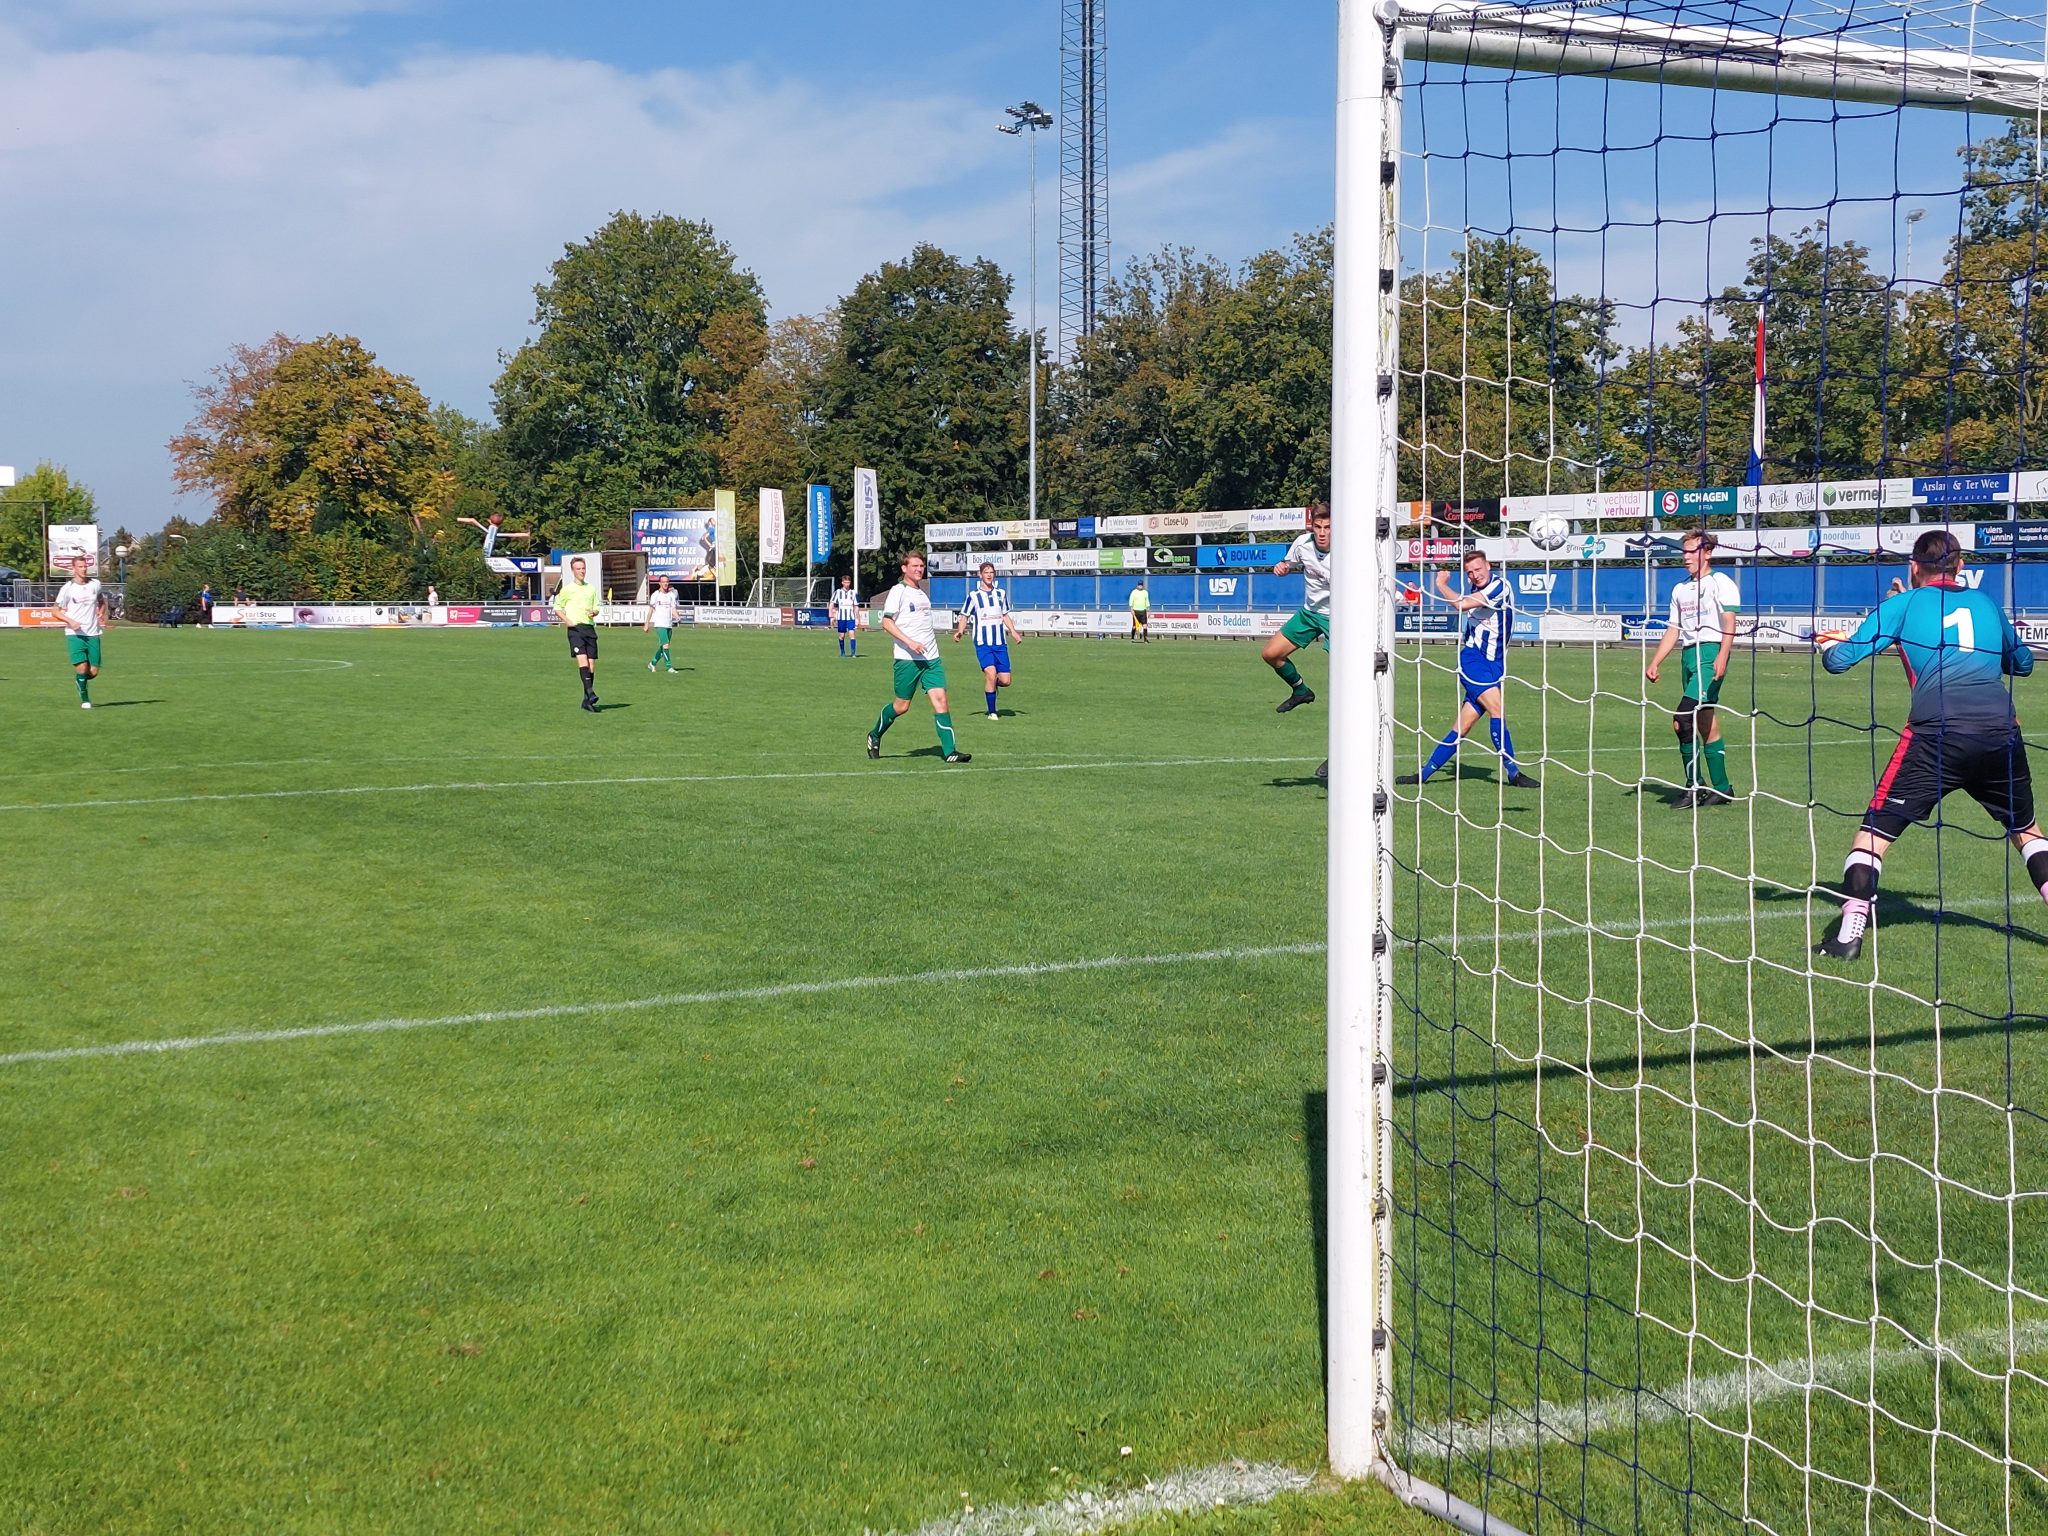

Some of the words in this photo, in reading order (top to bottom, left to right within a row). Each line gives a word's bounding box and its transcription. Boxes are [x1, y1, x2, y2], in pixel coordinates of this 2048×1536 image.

[1953, 481, 1962, 490] &
[1966, 480, 1979, 489] Ter
[1981, 479, 2000, 489] Wee
[863, 474, 874, 509] USV
[1683, 491, 1729, 503] SCHAGEN
[1839, 485, 1887, 503] vermeij
[1604, 493, 1640, 505] vechtdal
[1665, 494, 1676, 512] S
[1448, 513, 1486, 521] Comagner
[1605, 506, 1641, 516] verhuur
[638, 519, 650, 530] FF
[652, 518, 706, 530] BIJTANKEN
[1163, 516, 1189, 527] Close-Up
[983, 525, 1000, 536] USV
[1823, 530, 1861, 540] noordhuis
[641, 537, 656, 545] AAN
[657, 537, 667, 545] DE
[668, 537, 688, 545] POMP
[817, 526, 826, 555] JANSEN
[520, 561, 537, 569] USV
[648, 558, 675, 566] OODJES
[1011, 553, 1039, 565] HAMERS
[1209, 578, 1238, 593] USV
[1518, 574, 1557, 590] USV
[1954, 570, 1984, 589] SV
[321, 615, 366, 623] IMAGES
[797, 610, 810, 624] Epe
[1207, 614, 1221, 626] Bos
[1223, 614, 1252, 626] Bedden
[1769, 620, 1787, 628] USV
[1943, 607, 1975, 652] 1
